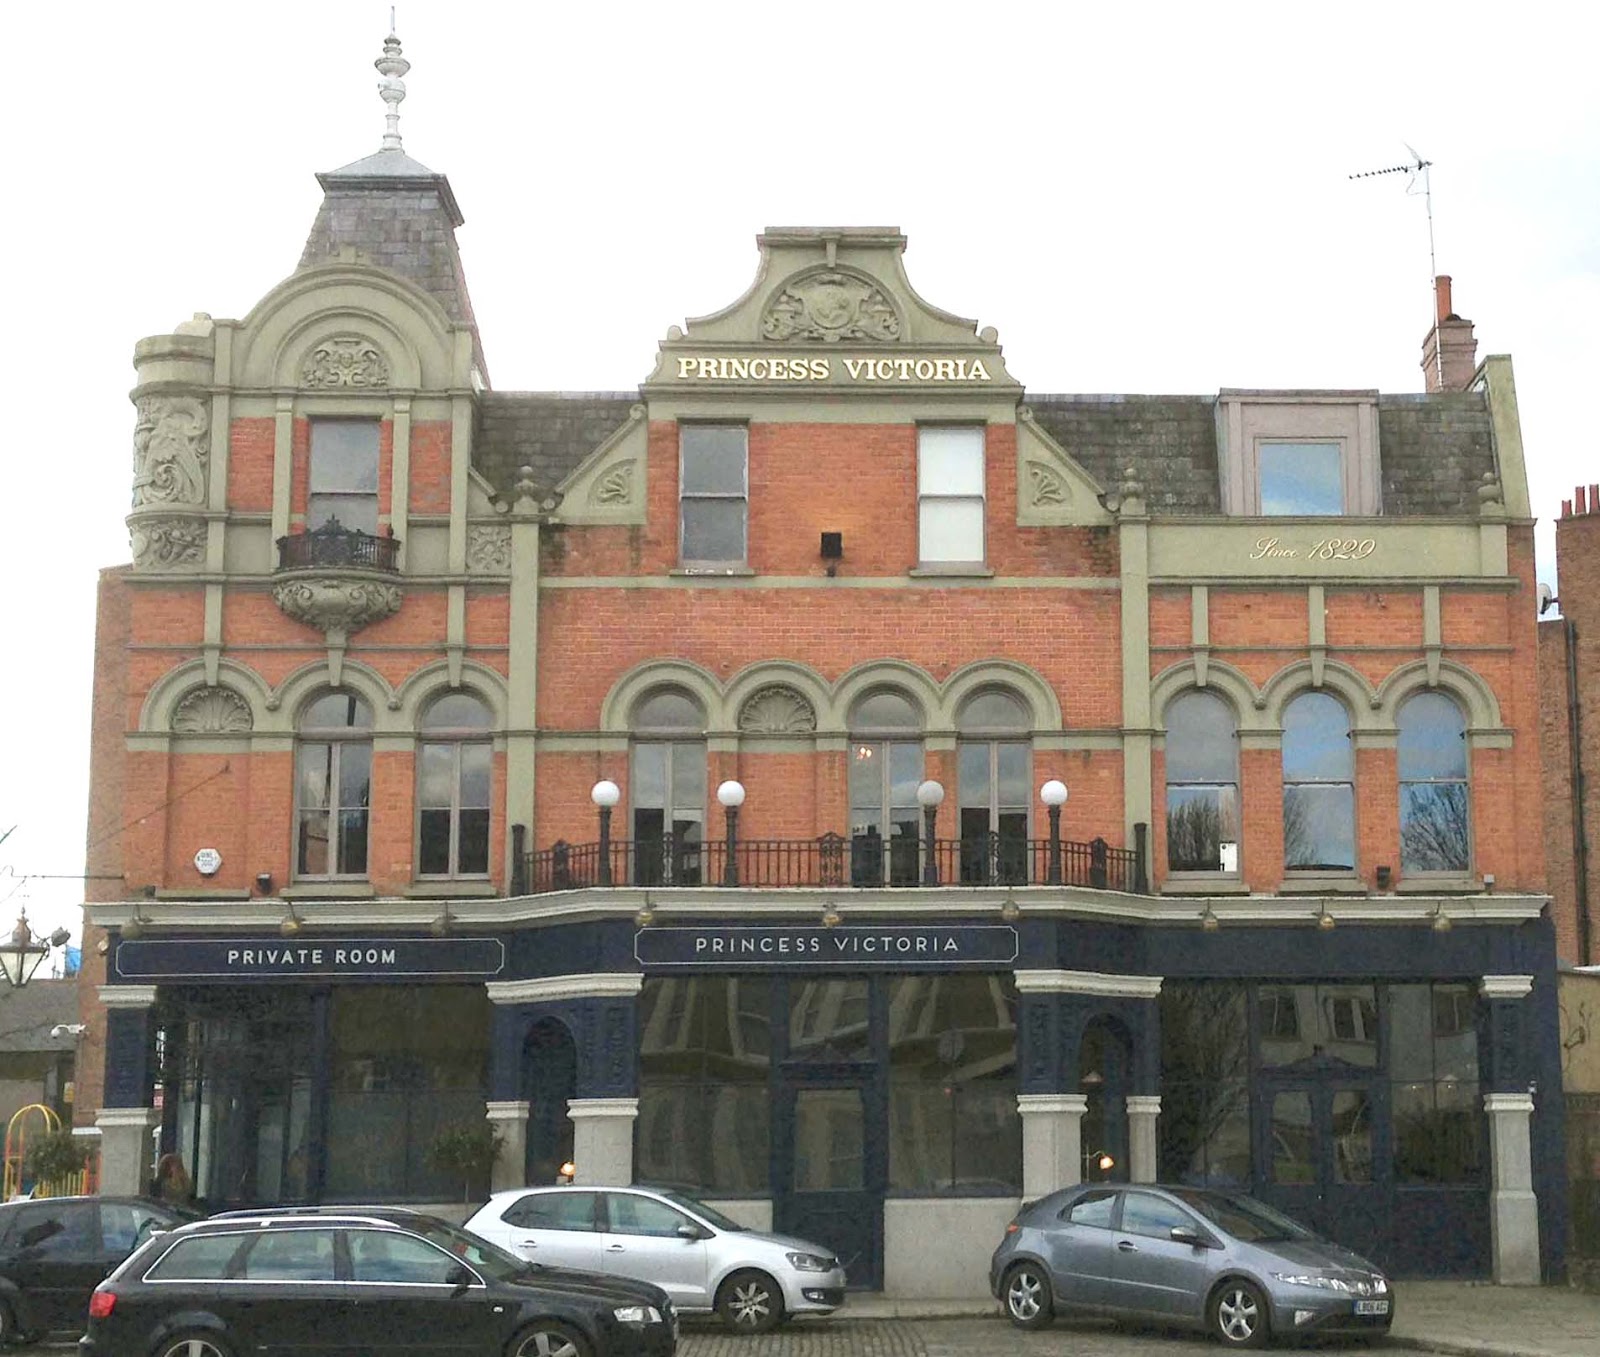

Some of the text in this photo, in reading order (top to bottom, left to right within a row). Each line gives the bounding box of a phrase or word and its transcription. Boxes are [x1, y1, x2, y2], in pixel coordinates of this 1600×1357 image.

[677, 357, 990, 381] PRINCESS VICTORIA
[1250, 536, 1376, 560] Since 1829
[695, 937, 959, 952] PRINCESS VICTORIA
[227, 949, 396, 964] PRIVATE ROOM
